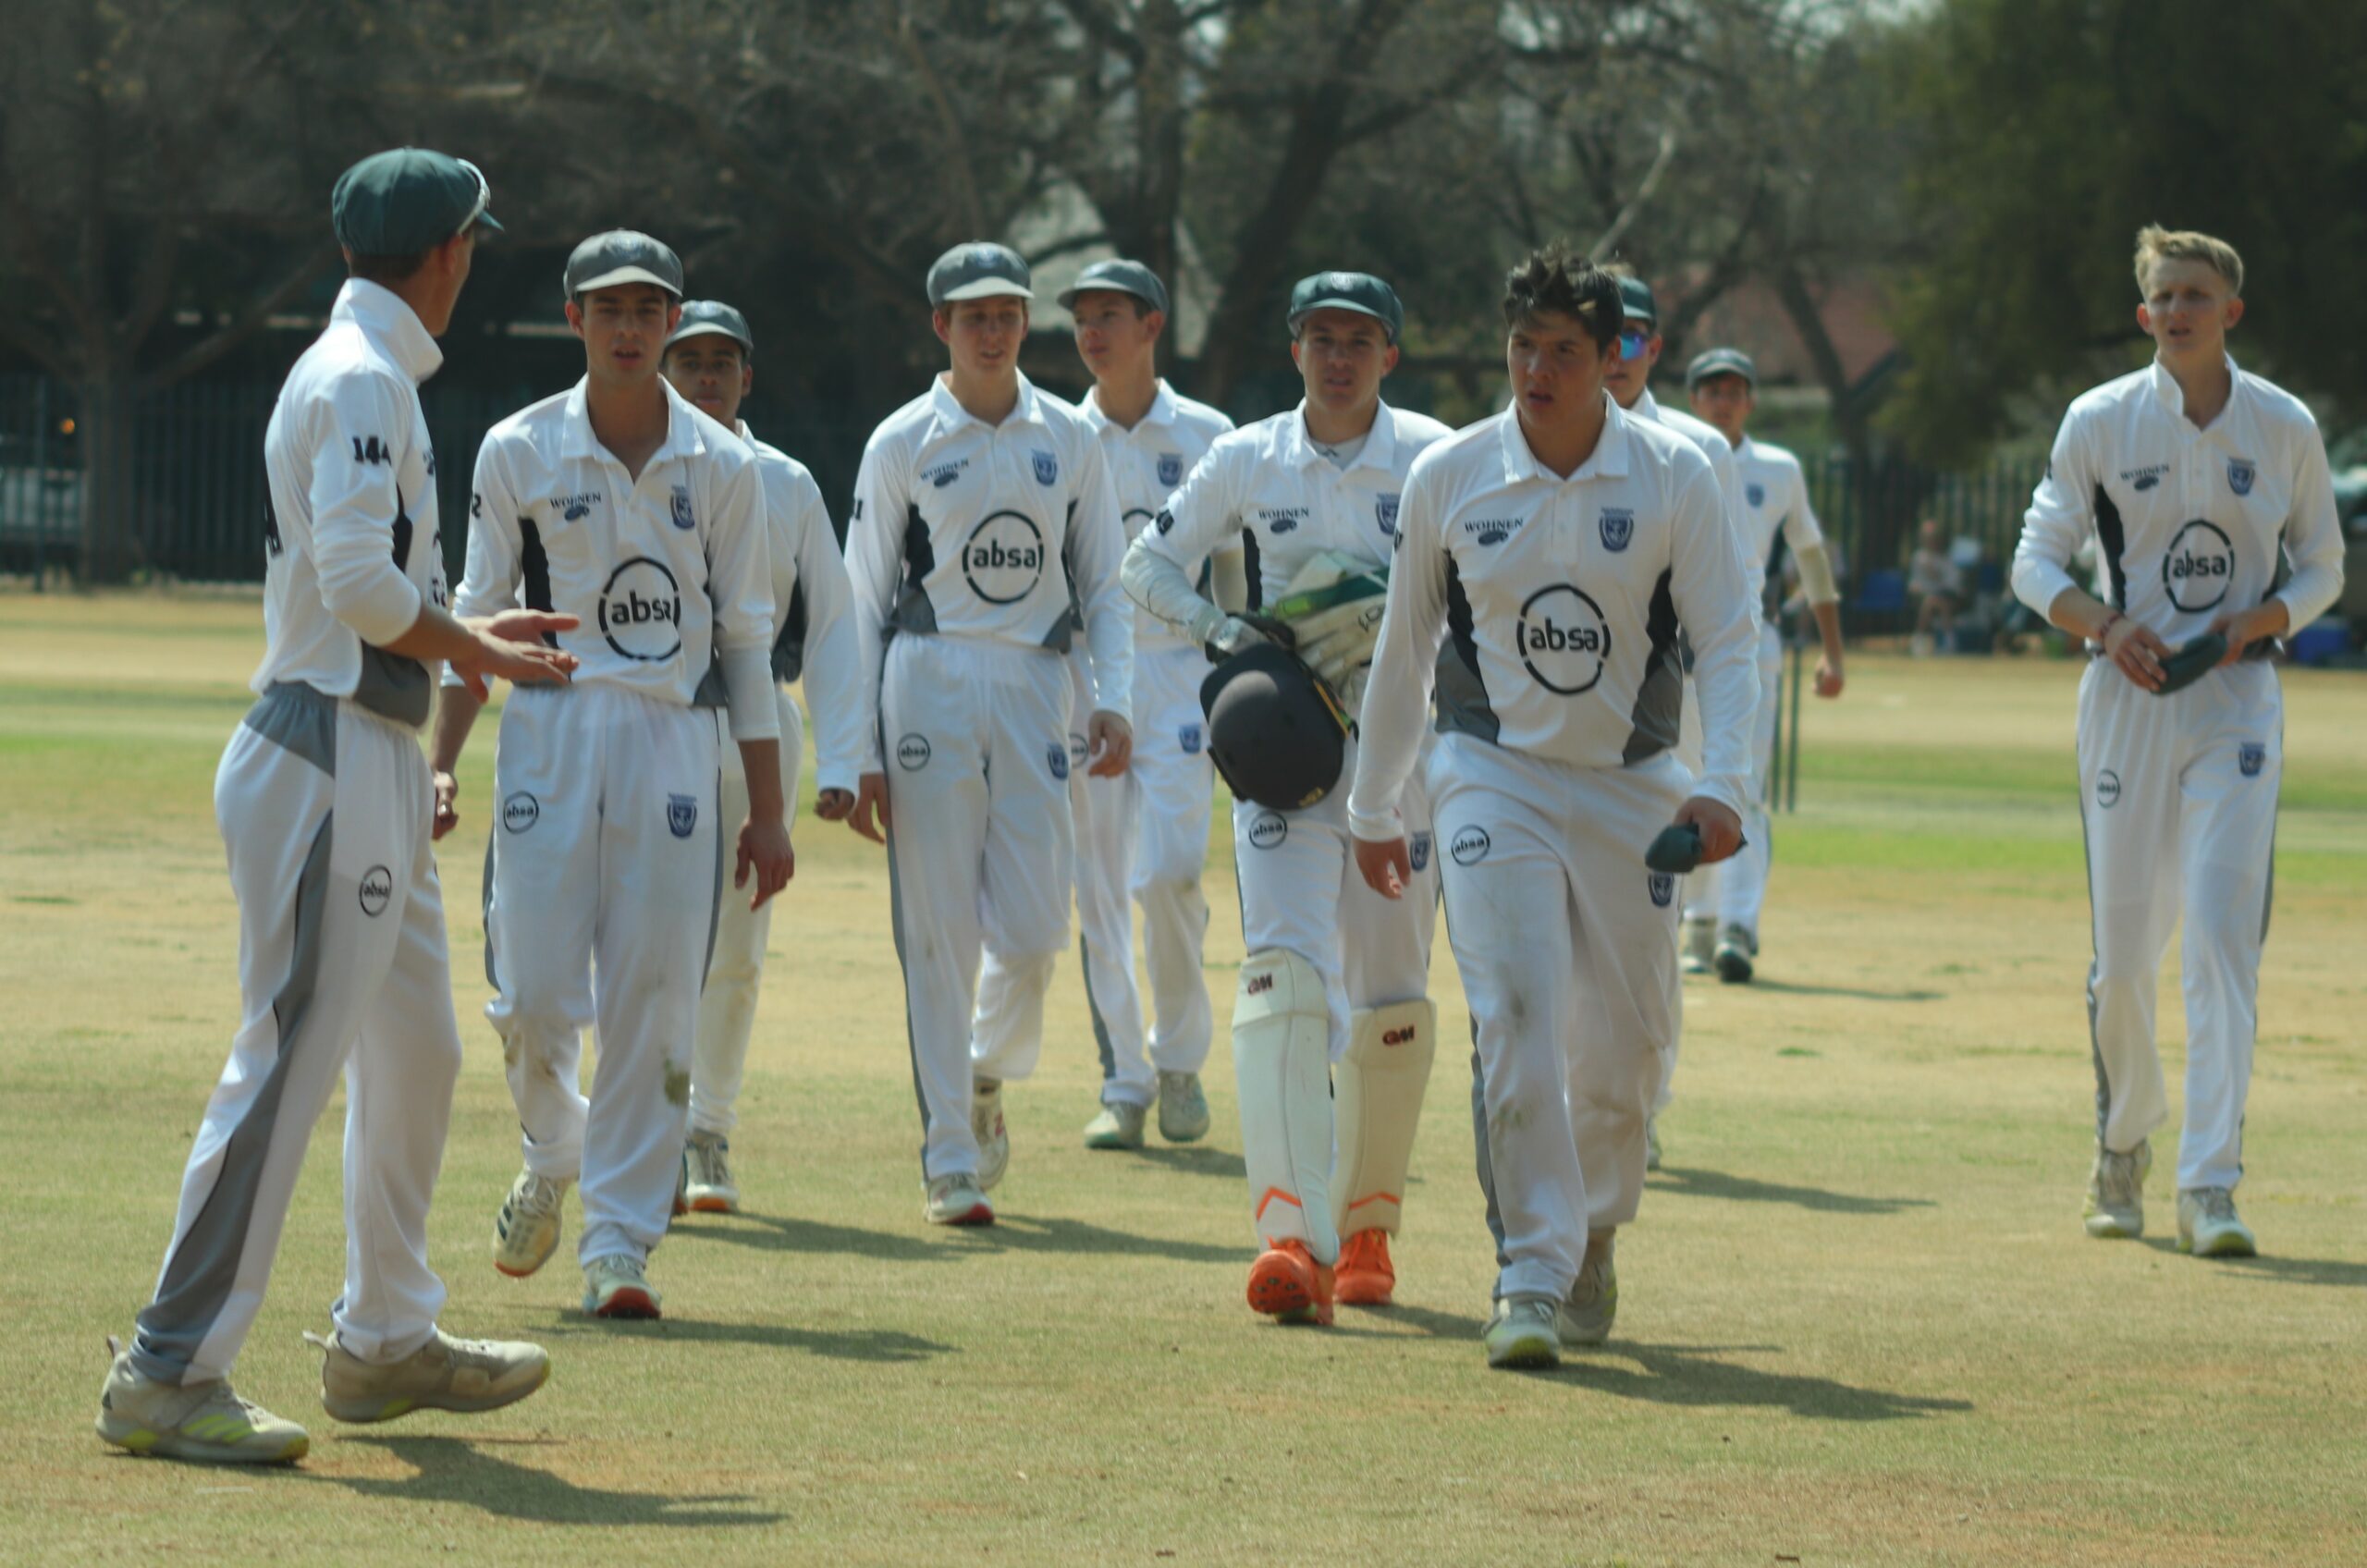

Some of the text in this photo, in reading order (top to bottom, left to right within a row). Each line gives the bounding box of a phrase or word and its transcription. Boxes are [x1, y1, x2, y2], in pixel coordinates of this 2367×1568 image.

[1465, 518, 1524, 533] WOHNEN
[973, 538, 1036, 569] absa
[2174, 549, 2226, 578] absa
[1530, 617, 1600, 651] absa
[1253, 819, 1283, 838] absa
[1454, 834, 1486, 853] absa
